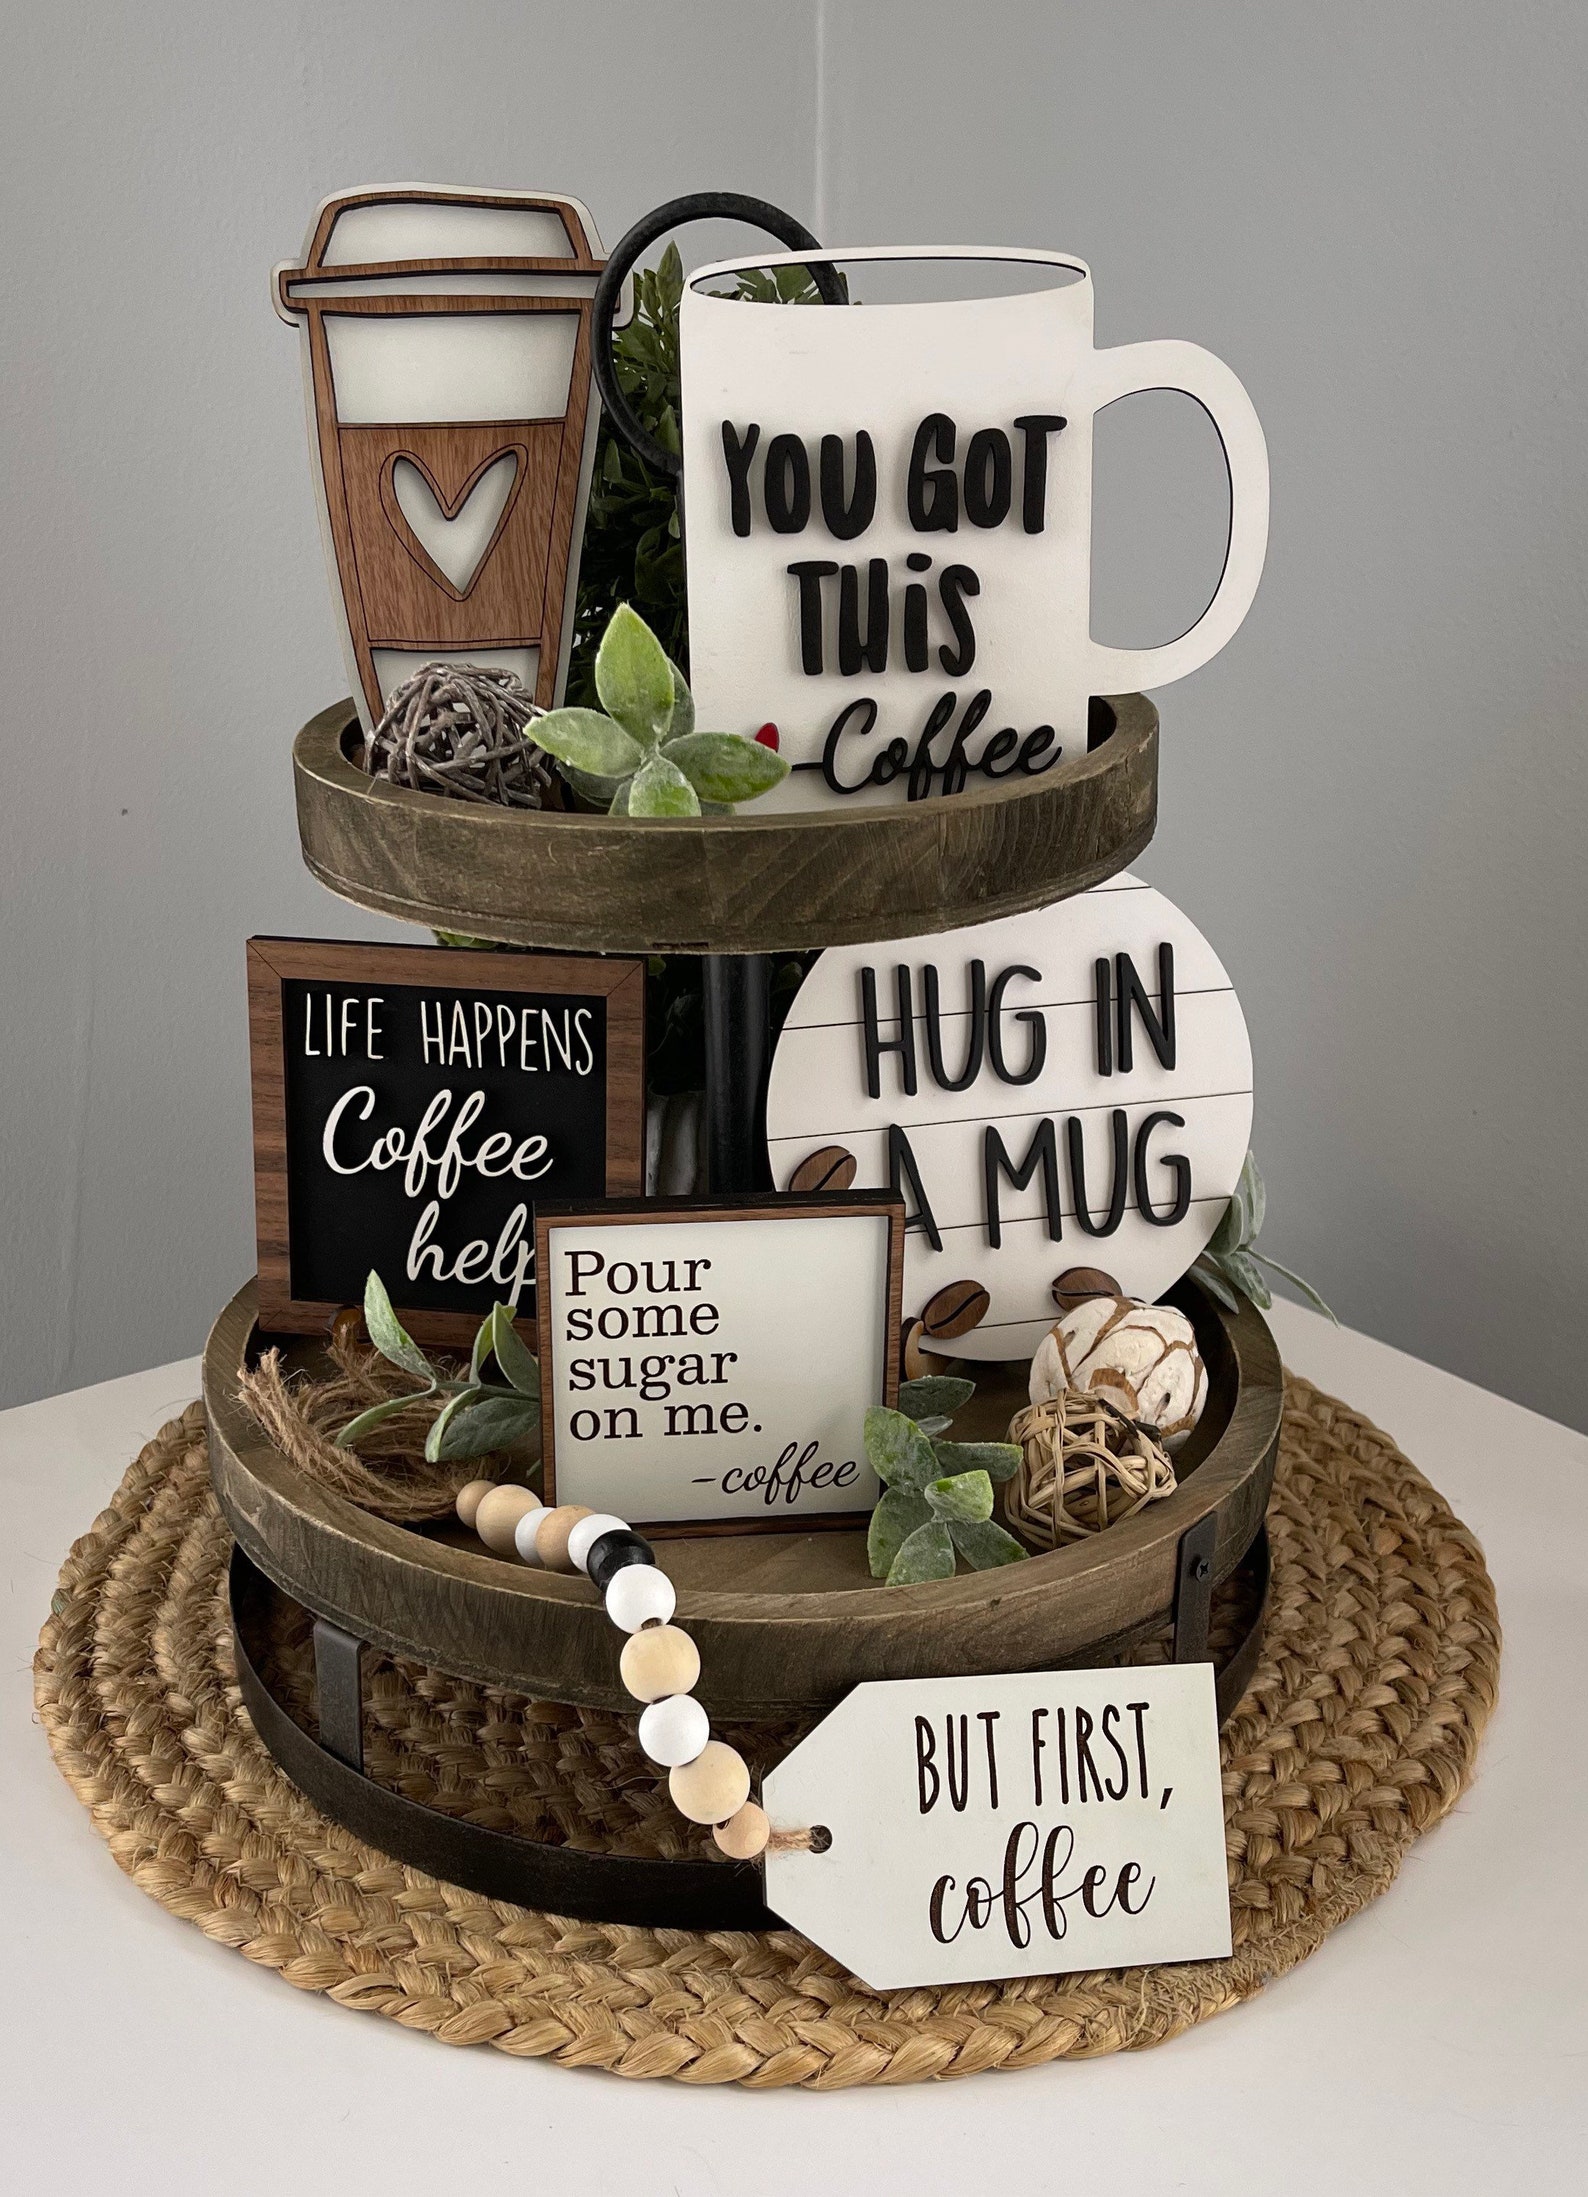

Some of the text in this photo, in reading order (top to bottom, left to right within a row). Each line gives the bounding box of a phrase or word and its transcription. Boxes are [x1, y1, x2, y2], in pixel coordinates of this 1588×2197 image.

[722, 413, 1067, 540] YOU GOT
[822, 689, 1062, 801] Coffee
[305, 992, 594, 1075] LIFE HAPPENS
[862, 942, 1175, 1099] HUG IN
[323, 1086, 553, 1199] Coffee
[889, 1109, 1191, 1252] A MUG
[564, 1250, 711, 1296] Pour
[566, 1303, 719, 1341] some
[569, 1352, 737, 1401] sugar
[570, 1401, 762, 1441] on me.
[914, 1702, 1173, 1815] BUT FIRST,
[929, 1821, 1156, 1949] coffee
